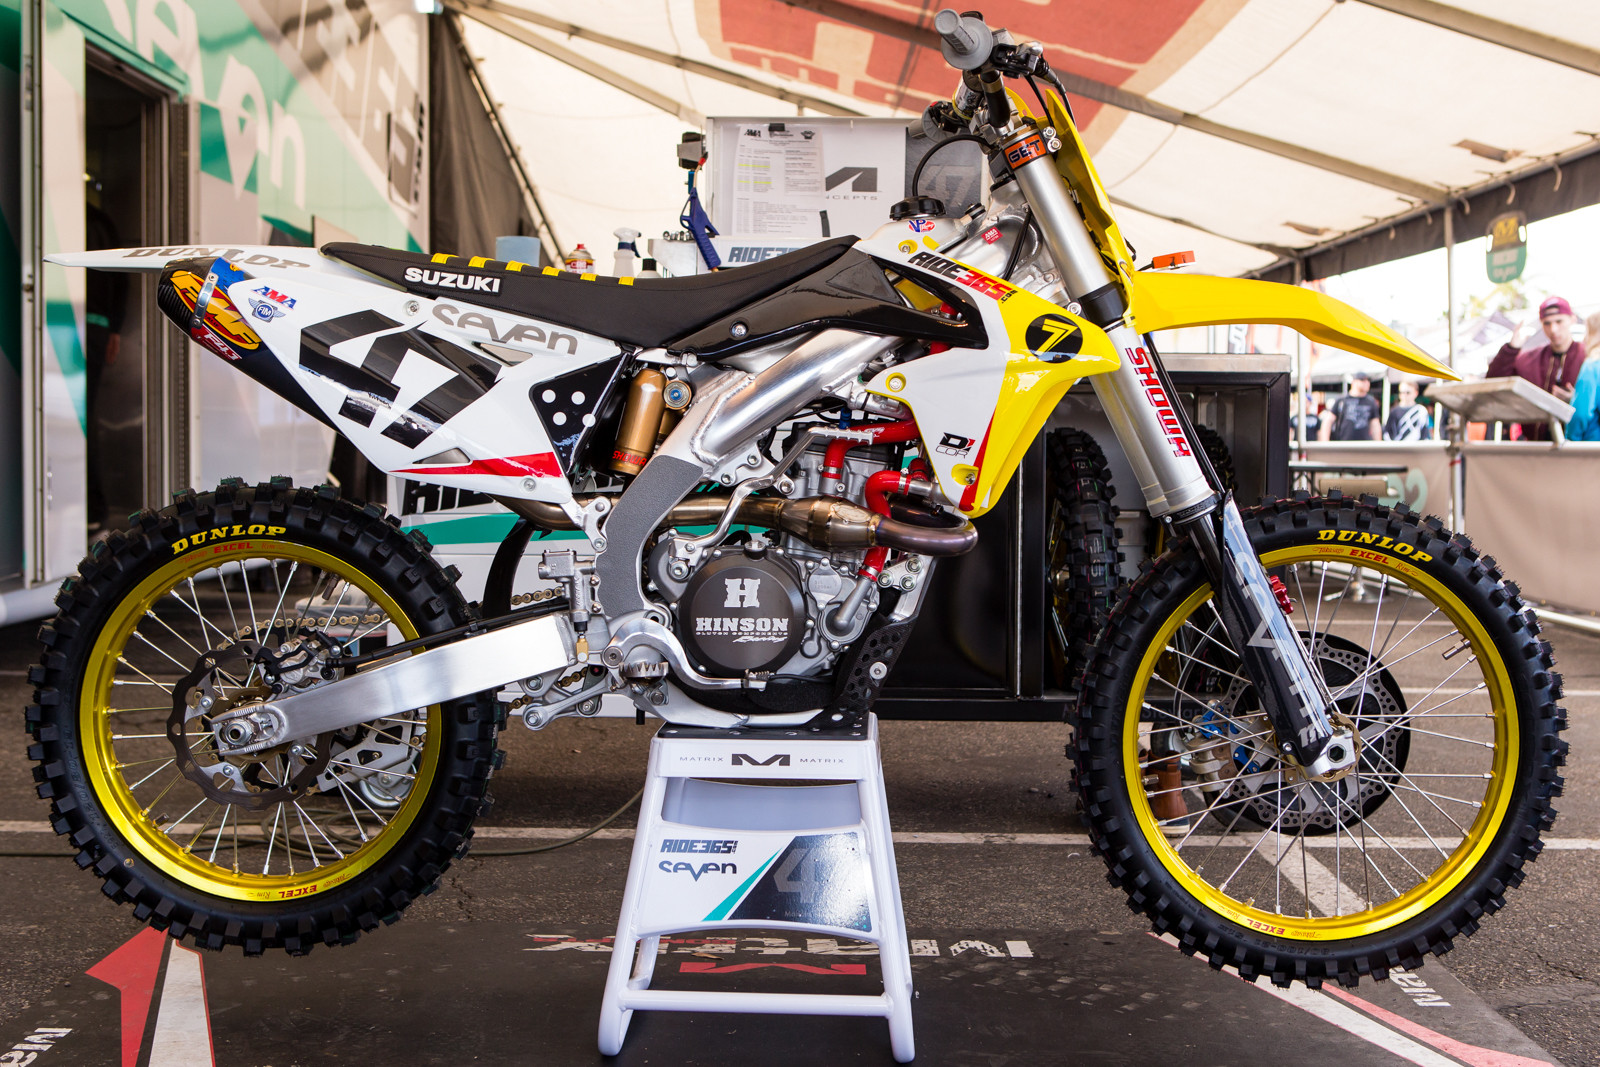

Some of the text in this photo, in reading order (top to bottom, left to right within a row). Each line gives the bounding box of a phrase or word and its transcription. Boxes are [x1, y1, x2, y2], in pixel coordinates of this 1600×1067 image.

[1008, 139, 1040, 163] GET
[123, 247, 311, 269] DUNLOP
[404, 267, 501, 293] SUZUKI
[252, 286, 297, 309] AMA
[258, 305, 272, 318] FIM
[1035, 318, 1079, 355] 7
[1125, 347, 1191, 458] SHOWA
[612, 450, 648, 467] SHOWA
[171, 524, 287, 555] DUNLOP
[213, 542, 254, 554] EXCEL
[1316, 529, 1433, 563] DUNLOP
[1349, 549, 1390, 565] EXCEL
[1395, 562, 1410, 574] Rim
[724, 578, 761, 608] H
[695, 617, 789, 632] HINSON
[278, 884, 318, 899] EXCEL
[1246, 918, 1286, 935] EXCEL
